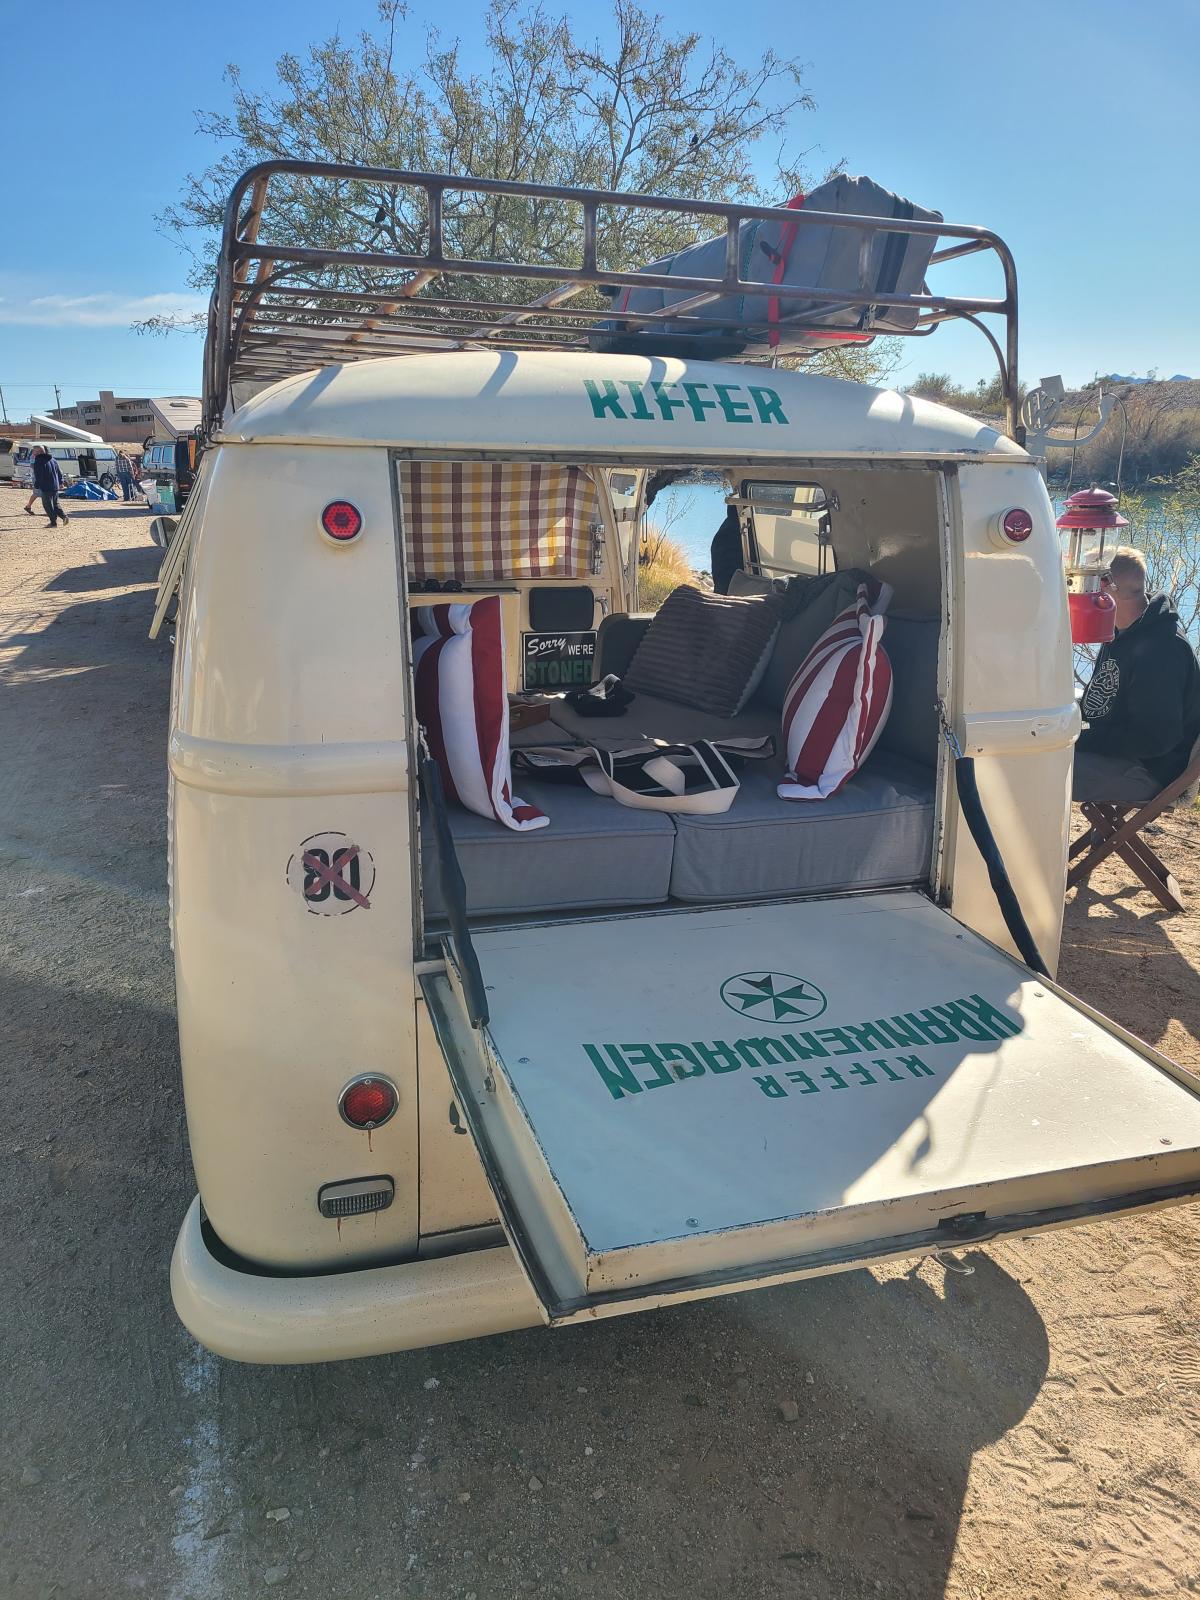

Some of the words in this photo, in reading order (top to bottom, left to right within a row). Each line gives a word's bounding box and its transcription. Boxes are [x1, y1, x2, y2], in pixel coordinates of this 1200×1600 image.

[583, 379, 790, 425] KIFFER
[527, 637, 567, 656] Sorry
[568, 644, 594, 656] WE'RE
[526, 660, 593, 685] STONED
[581, 993, 1026, 1100] KRANKENWAGEN
[752, 1054, 936, 1098] KIFFER
